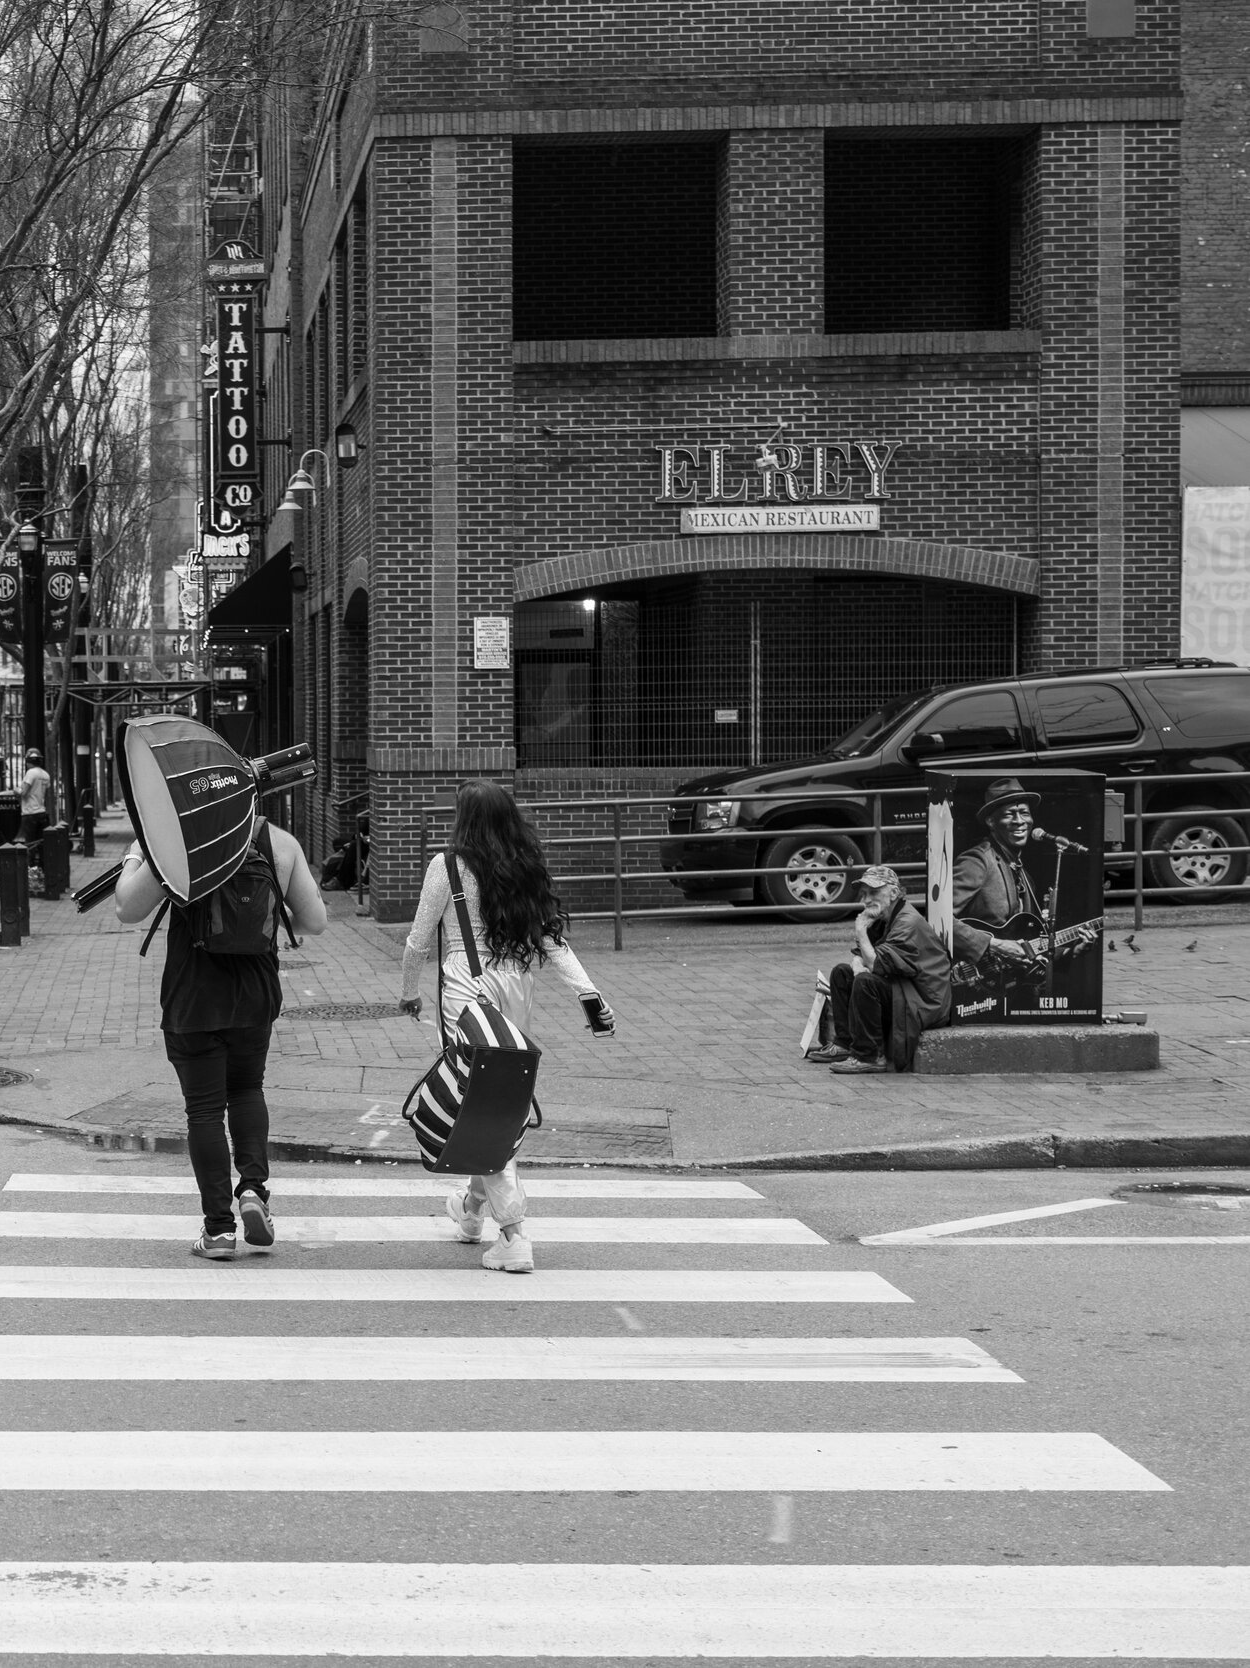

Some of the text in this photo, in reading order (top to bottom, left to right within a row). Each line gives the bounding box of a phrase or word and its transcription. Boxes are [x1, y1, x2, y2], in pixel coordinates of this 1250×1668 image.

[223, 303, 249, 467] TATTOO
[655, 440, 903, 503] EL REY
[688, 510, 874, 528] MEXICAN RESTAURANT
[202, 533, 250, 557] JACK'S
[47, 556, 77, 566] FANS
[51, 575, 72, 597] SEC
[189, 775, 239, 794] Phottix 65
[1039, 997, 1069, 1009] KEB MO
